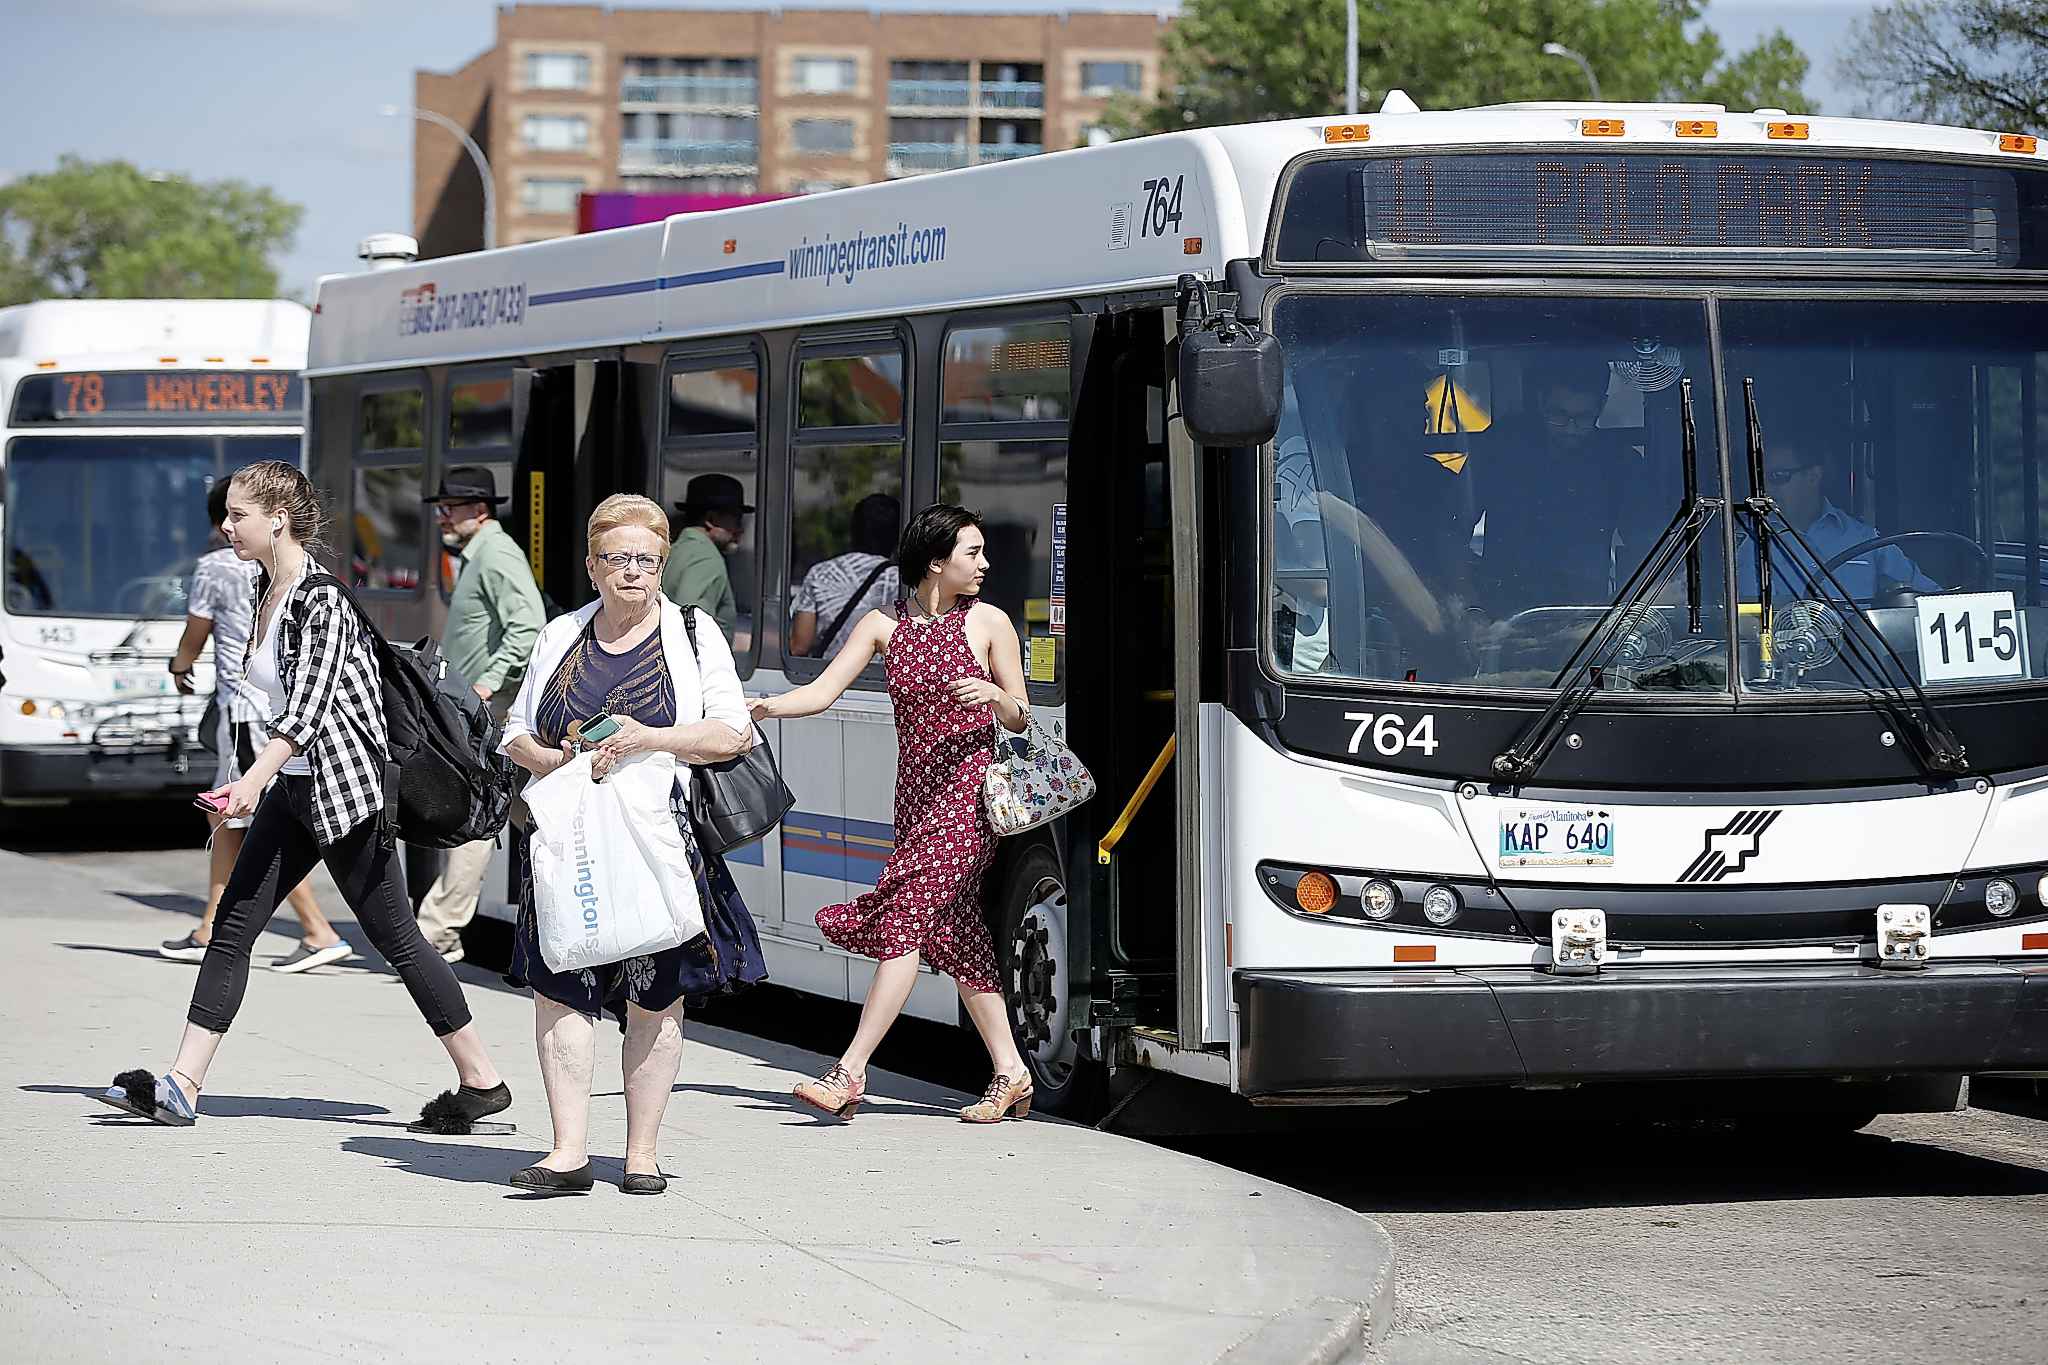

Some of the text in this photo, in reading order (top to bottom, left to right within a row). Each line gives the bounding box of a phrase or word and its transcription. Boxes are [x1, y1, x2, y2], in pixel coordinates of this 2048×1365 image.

[1140, 174, 1184, 238] 764
[1384, 159, 1873, 247] 11 POLO PARK
[789, 222, 946, 287] winnipegtransit.com
[62, 373, 290, 415] 78 WAVERLEY
[1929, 609, 2017, 665] 11-5
[1343, 711, 1439, 757] 764
[1505, 822, 1609, 851] KAP 640
[1551, 810, 1587, 822] Manitoba
